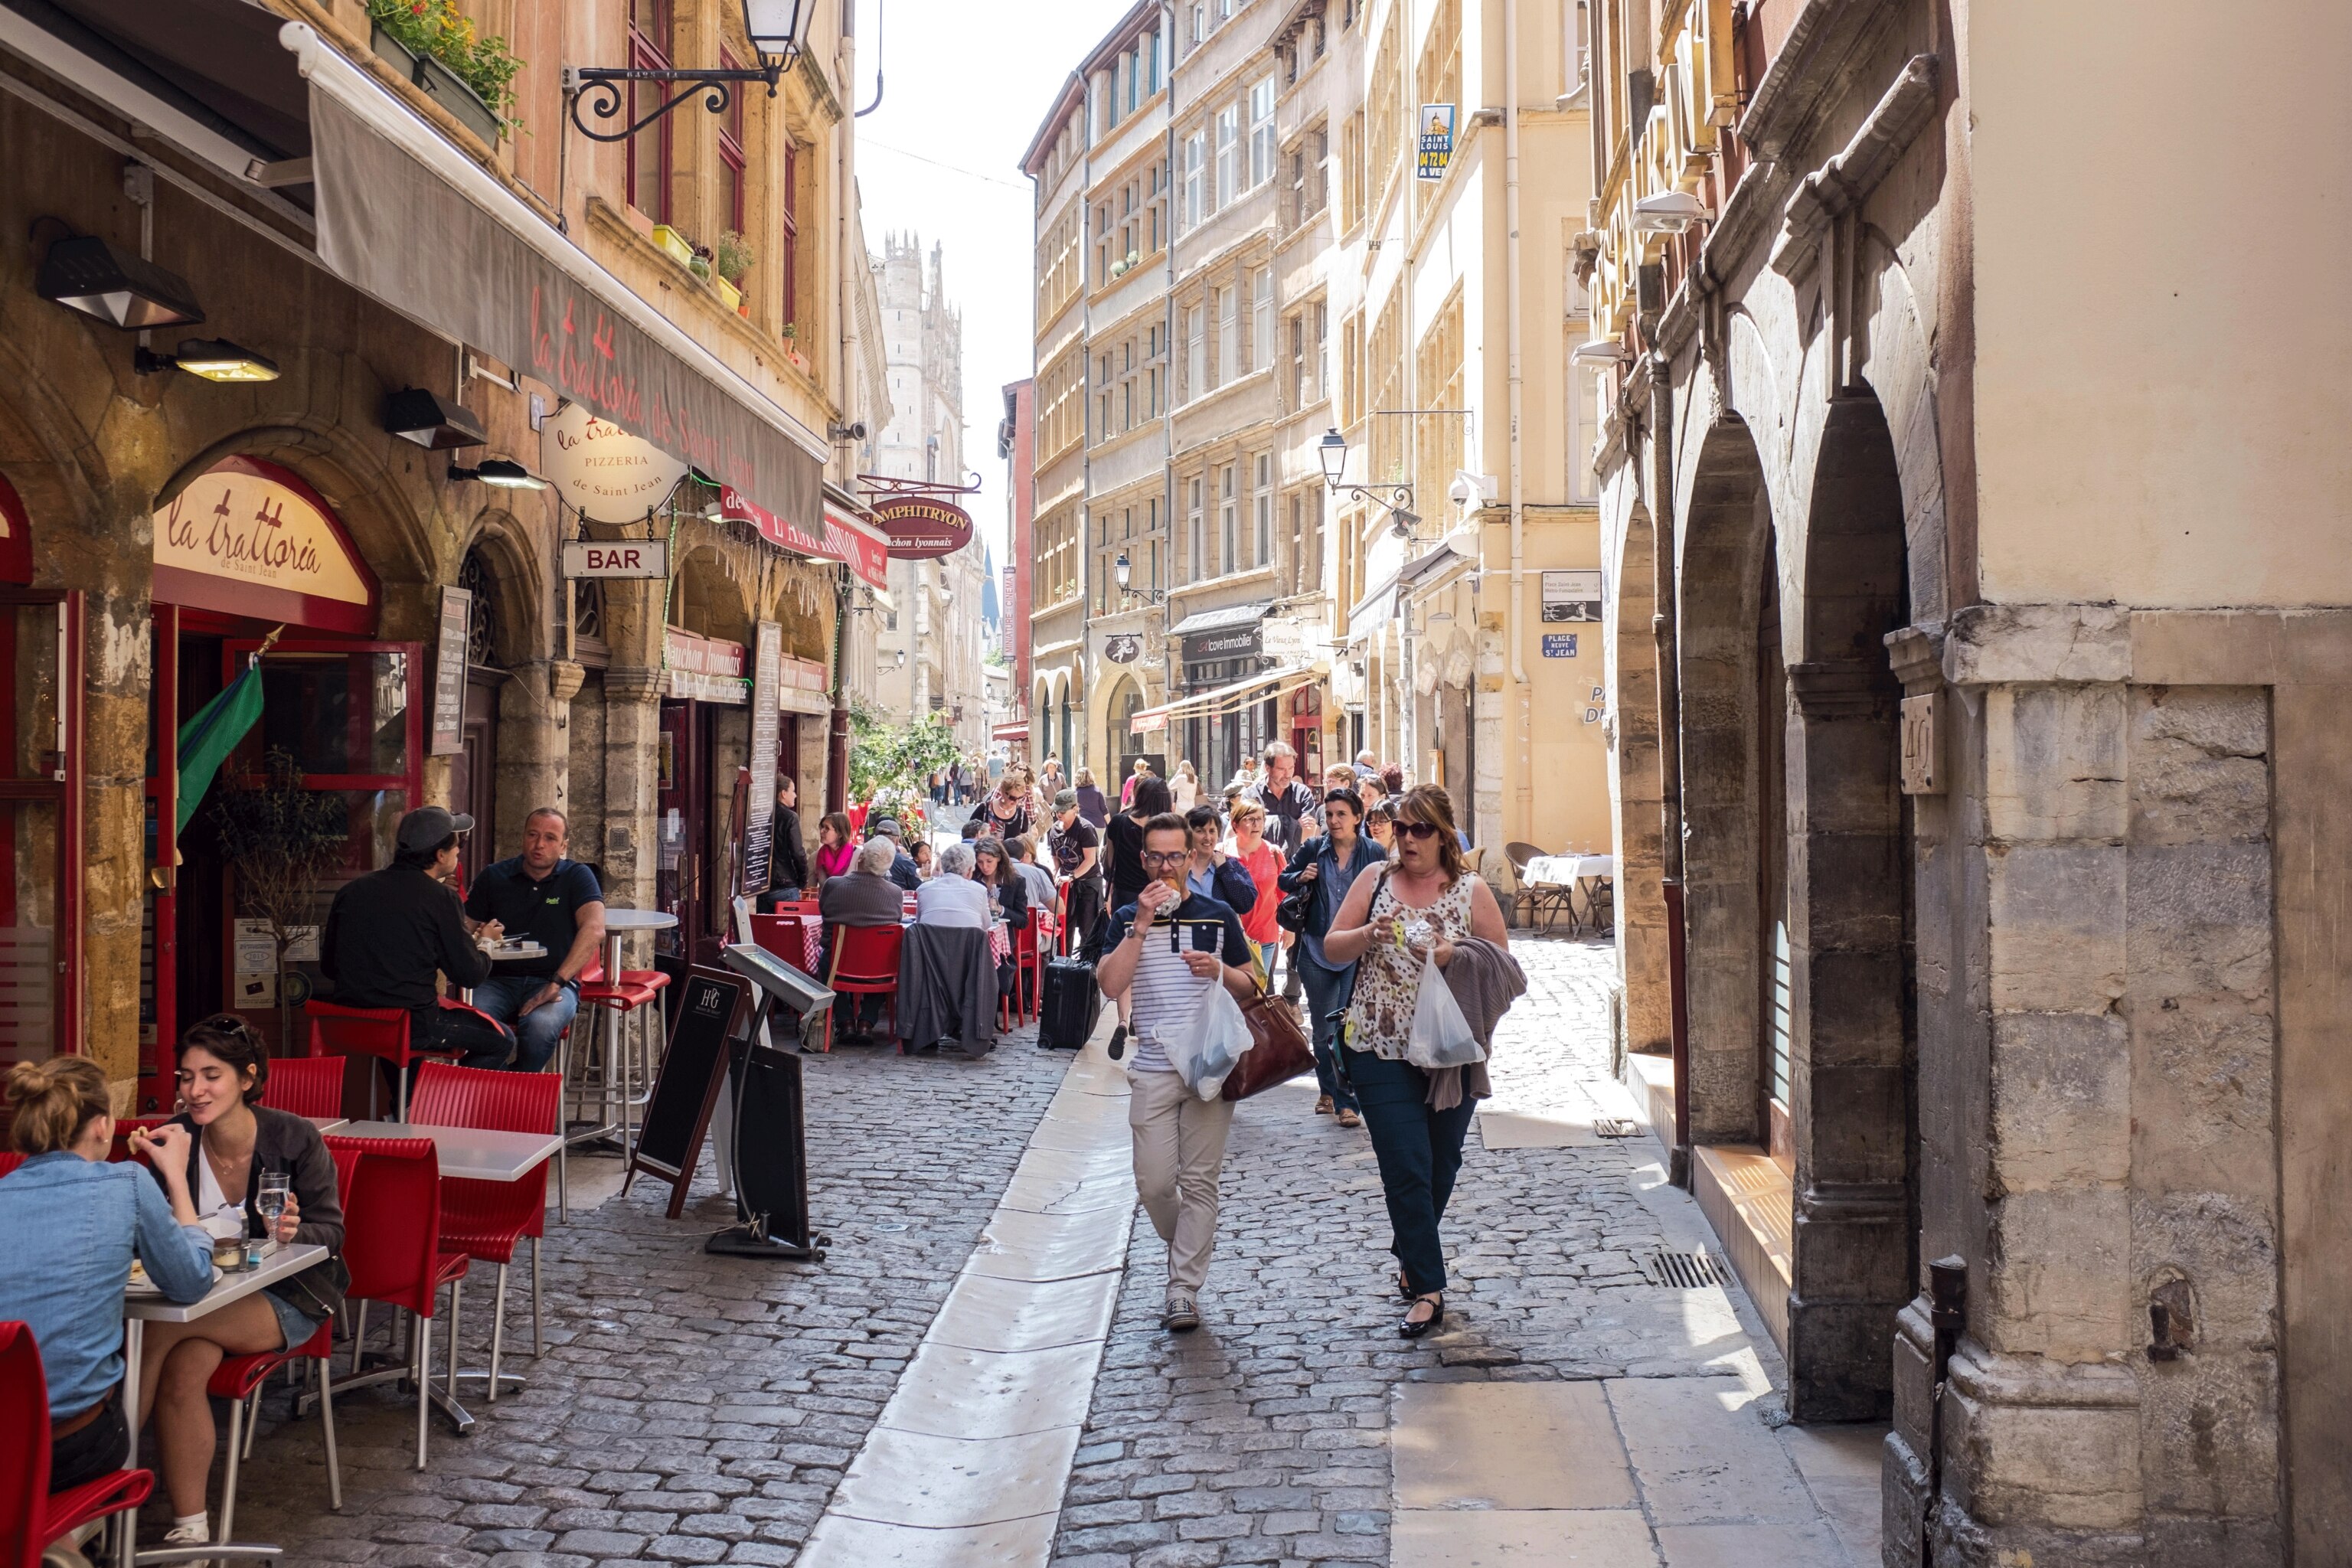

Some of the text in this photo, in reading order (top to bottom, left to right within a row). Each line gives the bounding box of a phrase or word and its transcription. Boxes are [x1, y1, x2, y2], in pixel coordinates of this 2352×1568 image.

[1419, 152, 1448, 167] 04 72 84
[1419, 168, 1426, 176] A
[531, 286, 755, 491] la trattoria de Saint Jean
[557, 430, 580, 450] la
[585, 456, 648, 467] PIZZERIA
[573, 476, 662, 497] de Saint Jean
[168, 488, 322, 574] la trattoria
[915, 537, 952, 549] lyonnais
[220, 558, 277, 579] de Saint Jean
[587, 550, 641, 569] BAR
[1004, 577, 1014, 607] CINEMA
[1004, 613, 1014, 653] MINIATURE
[1197, 633, 1253, 652] Alcove Immobilier
[1272, 635, 1288, 645] Vieux
[1288, 636, 1301, 645] Lyon
[706, 643, 741, 676] lyonnais
[798, 663, 823, 691] lyonnais
